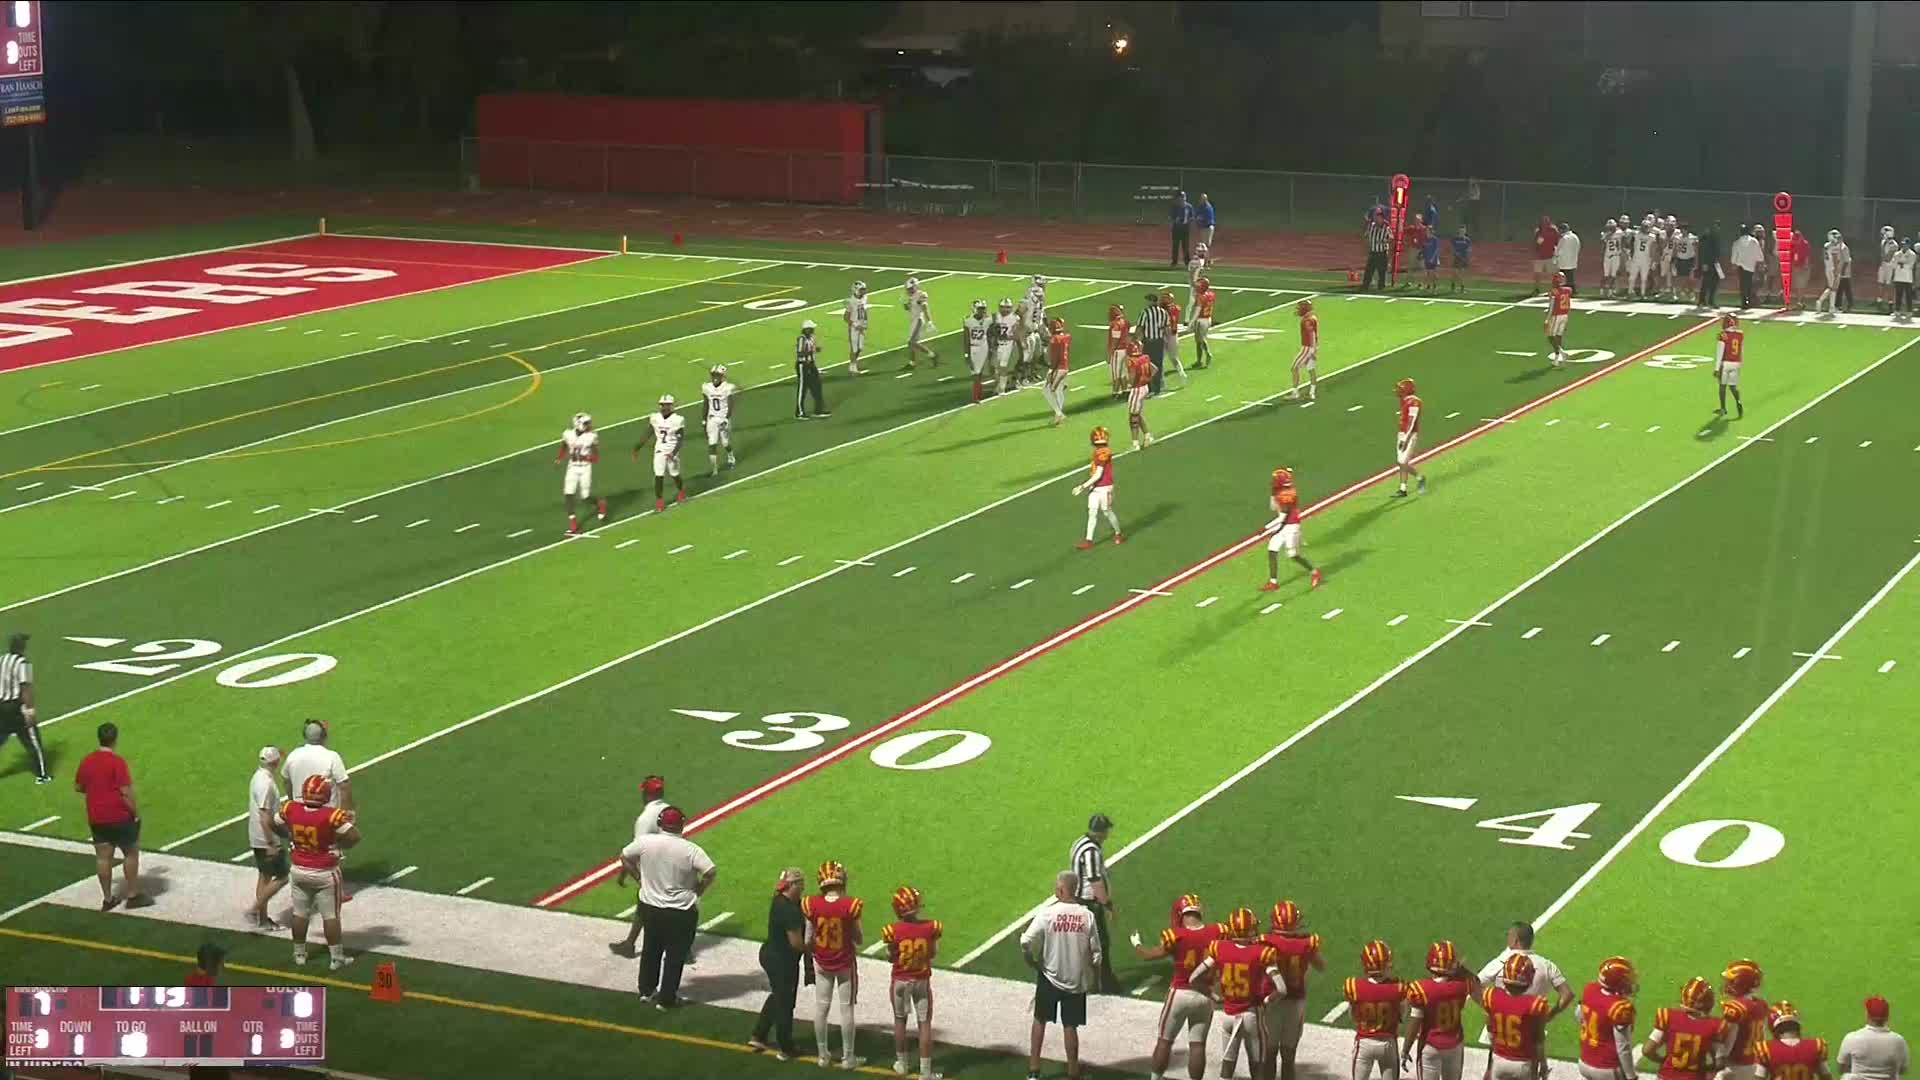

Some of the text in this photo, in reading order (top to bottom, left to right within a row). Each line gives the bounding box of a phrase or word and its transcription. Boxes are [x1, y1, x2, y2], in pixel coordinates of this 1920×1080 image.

[18, 32, 37, 42] TIME
[18, 45, 38, 57] OUTS
[19, 60, 37, 71] LEFT
[1639, 241, 1646, 252] 5
[1731, 337, 1740, 356] 9
[712, 398, 721, 412] 0
[659, 430, 668, 443] 7
[1056, 914, 1083, 922] DO THE
[1053, 921, 1086, 932] WORK
[1221, 963, 1250, 998] 45
[1494, 1013, 1522, 1047] 16
